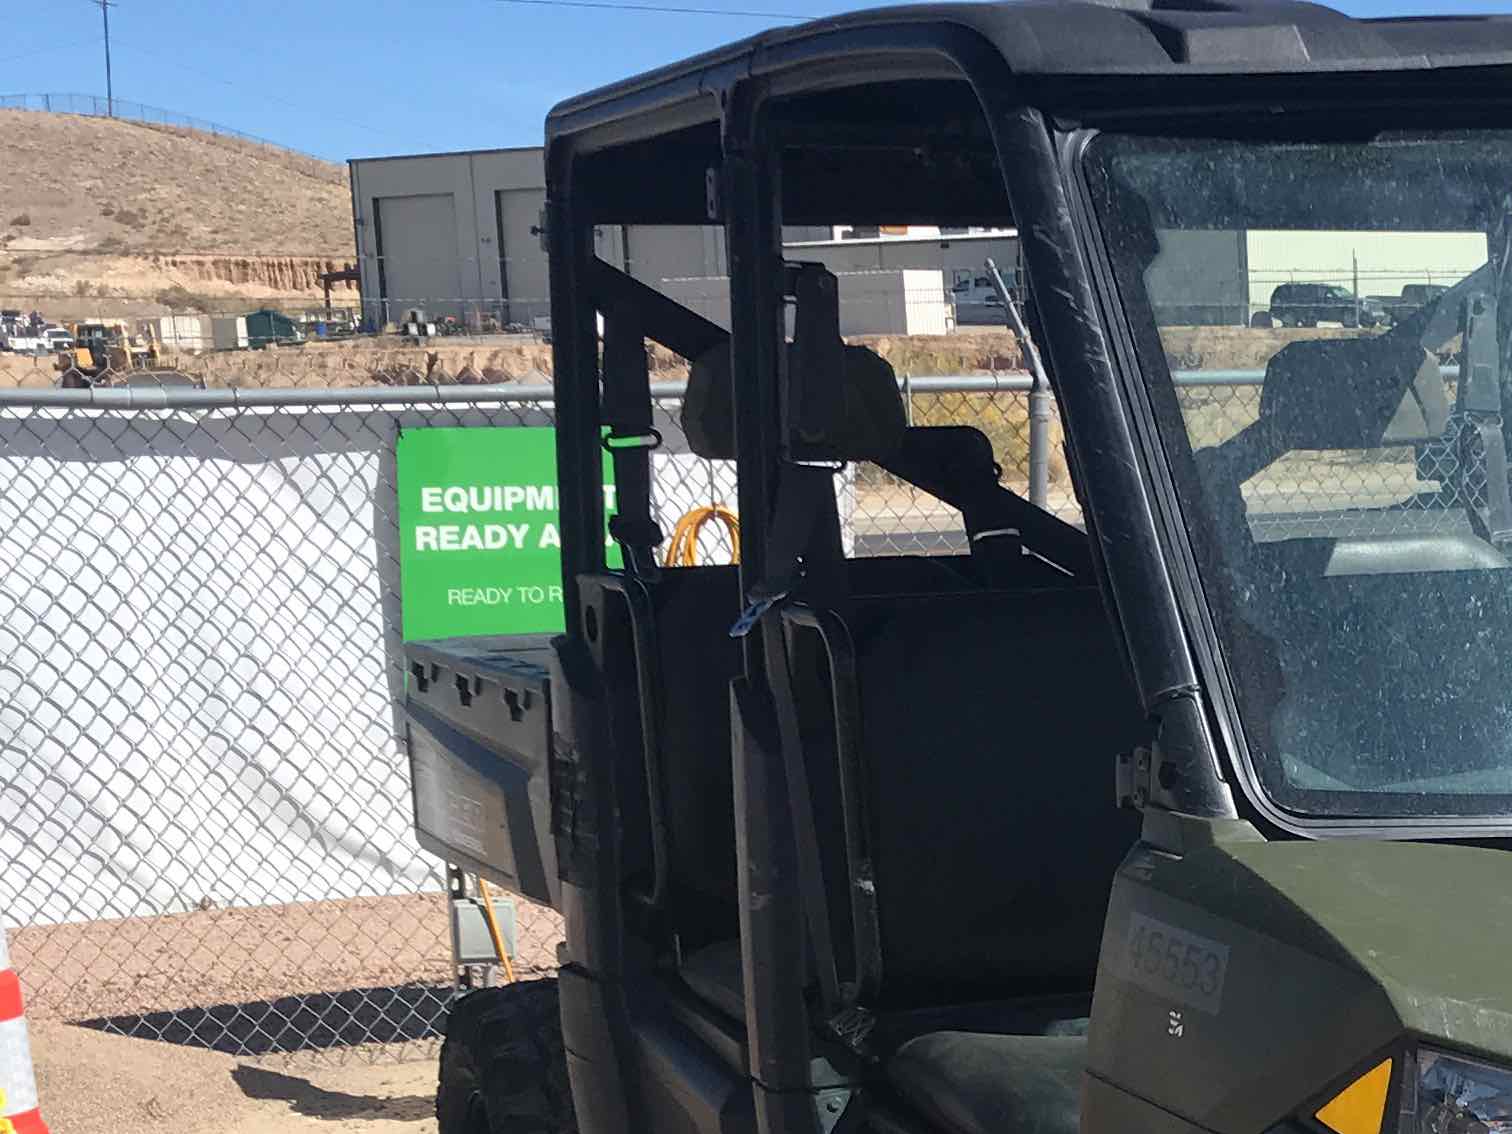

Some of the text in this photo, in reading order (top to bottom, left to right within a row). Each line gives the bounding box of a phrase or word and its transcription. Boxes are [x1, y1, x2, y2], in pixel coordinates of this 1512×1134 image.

[421, 485, 616, 513] EQUIPMT
[415, 524, 529, 551] READY
[448, 588, 512, 605] READY
[516, 586, 544, 604] TO
